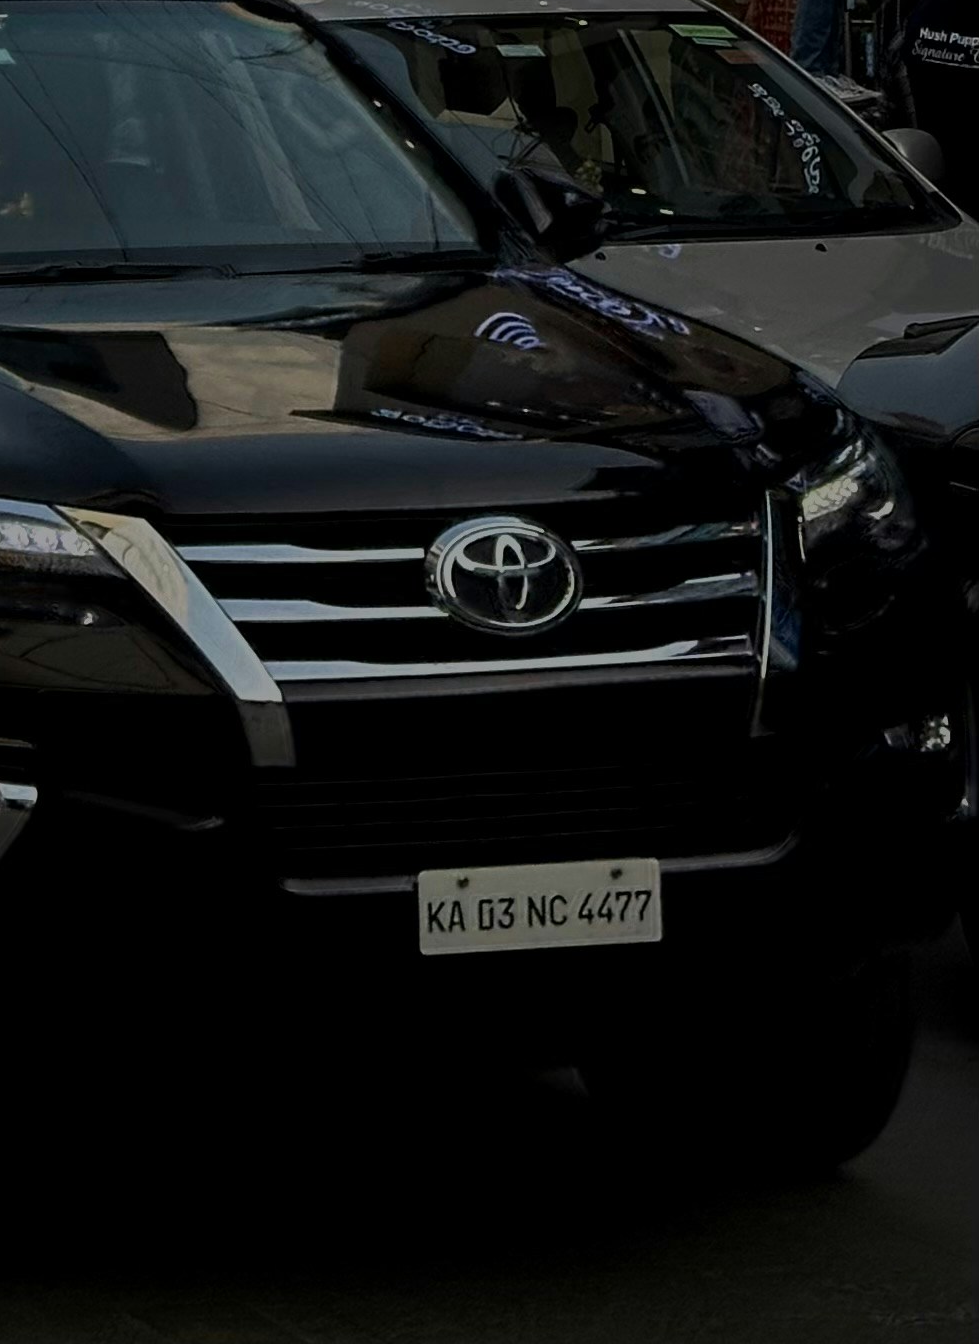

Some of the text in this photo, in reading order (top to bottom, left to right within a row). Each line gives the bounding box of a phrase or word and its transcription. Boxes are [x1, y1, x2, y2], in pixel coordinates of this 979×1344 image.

[911, 38, 966, 62] Signature
[427, 889, 652, 934] KA 03 NC 4477
